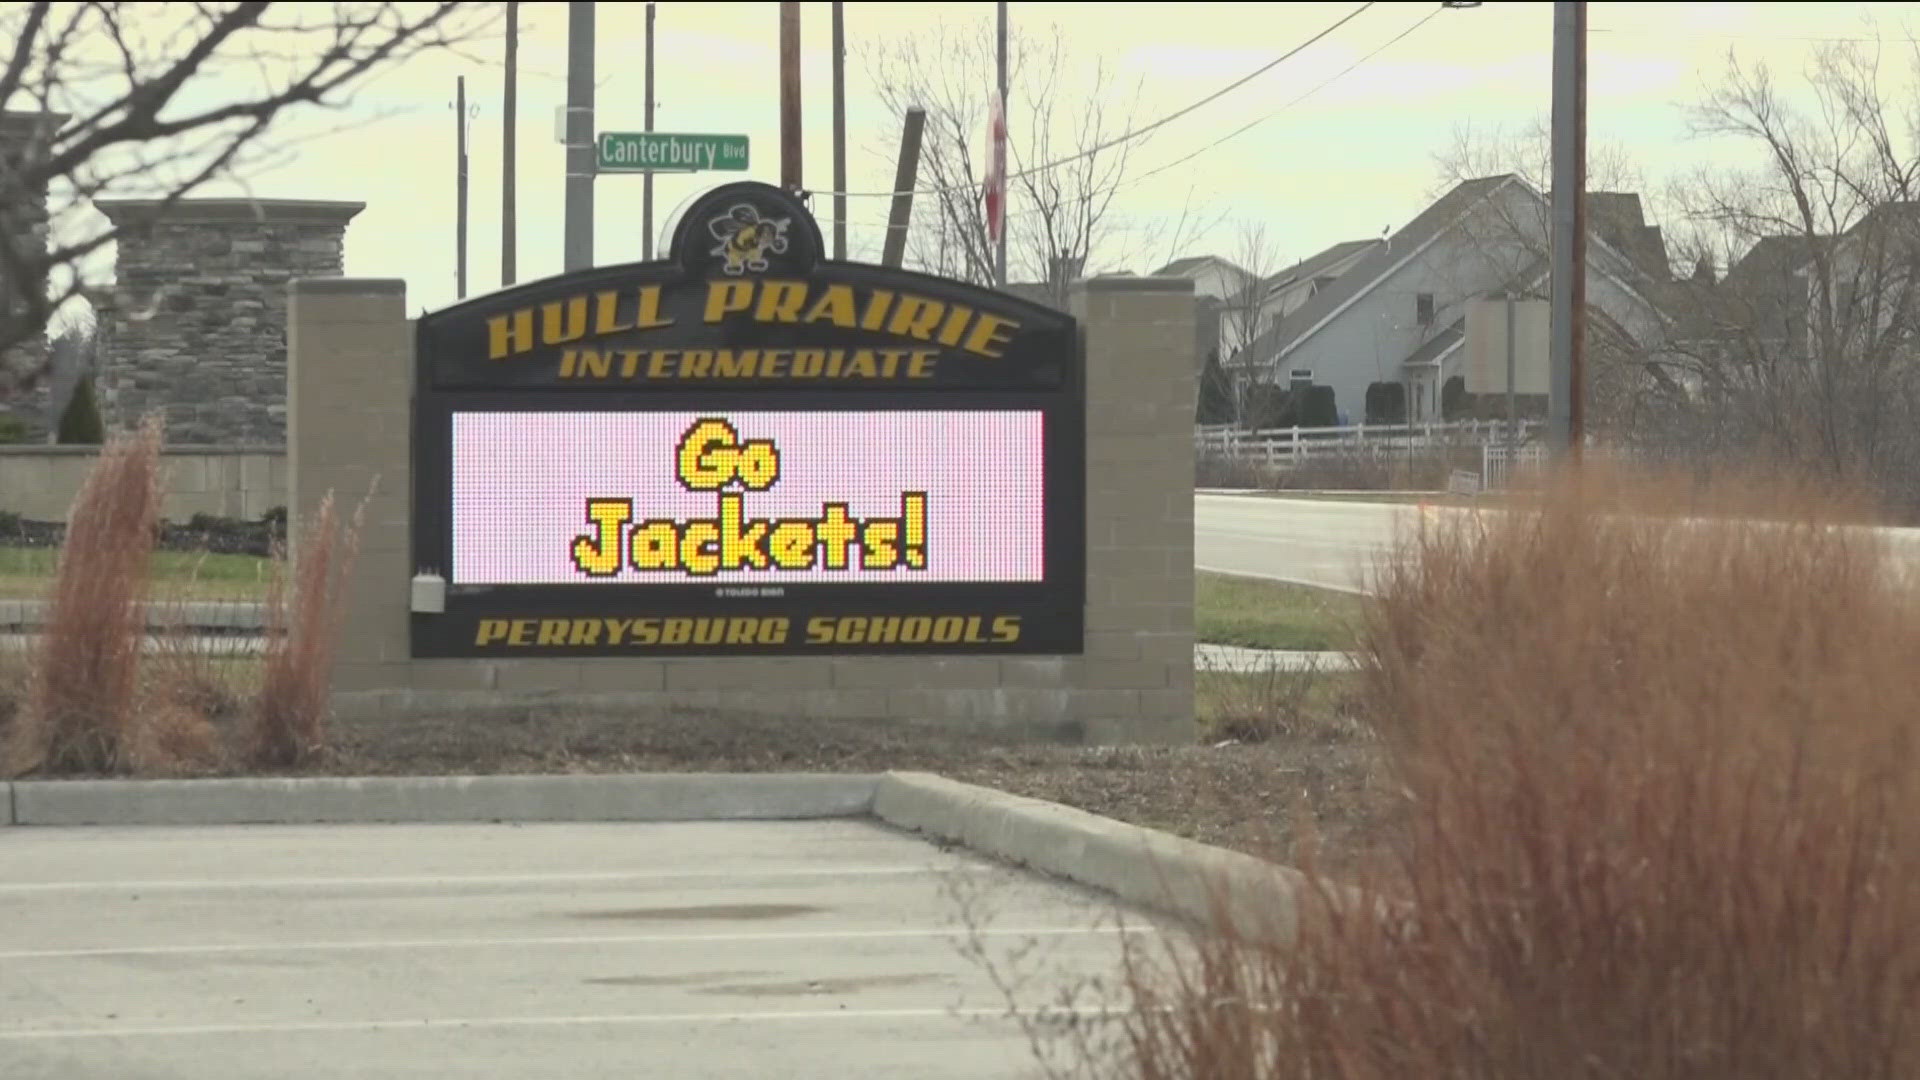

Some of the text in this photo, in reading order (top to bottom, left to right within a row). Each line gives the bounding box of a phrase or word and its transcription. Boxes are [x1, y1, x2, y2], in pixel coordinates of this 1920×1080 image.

[602, 135, 745, 169] Canterbury Blvd
[487, 280, 1021, 360] HULL PRAIRIE
[558, 349, 937, 379] INTERMEDIATE
[675, 417, 780, 491] Go
[571, 491, 928, 577] Jackets!
[474, 616, 1021, 646] PERRYSBURG SCHOOLS
